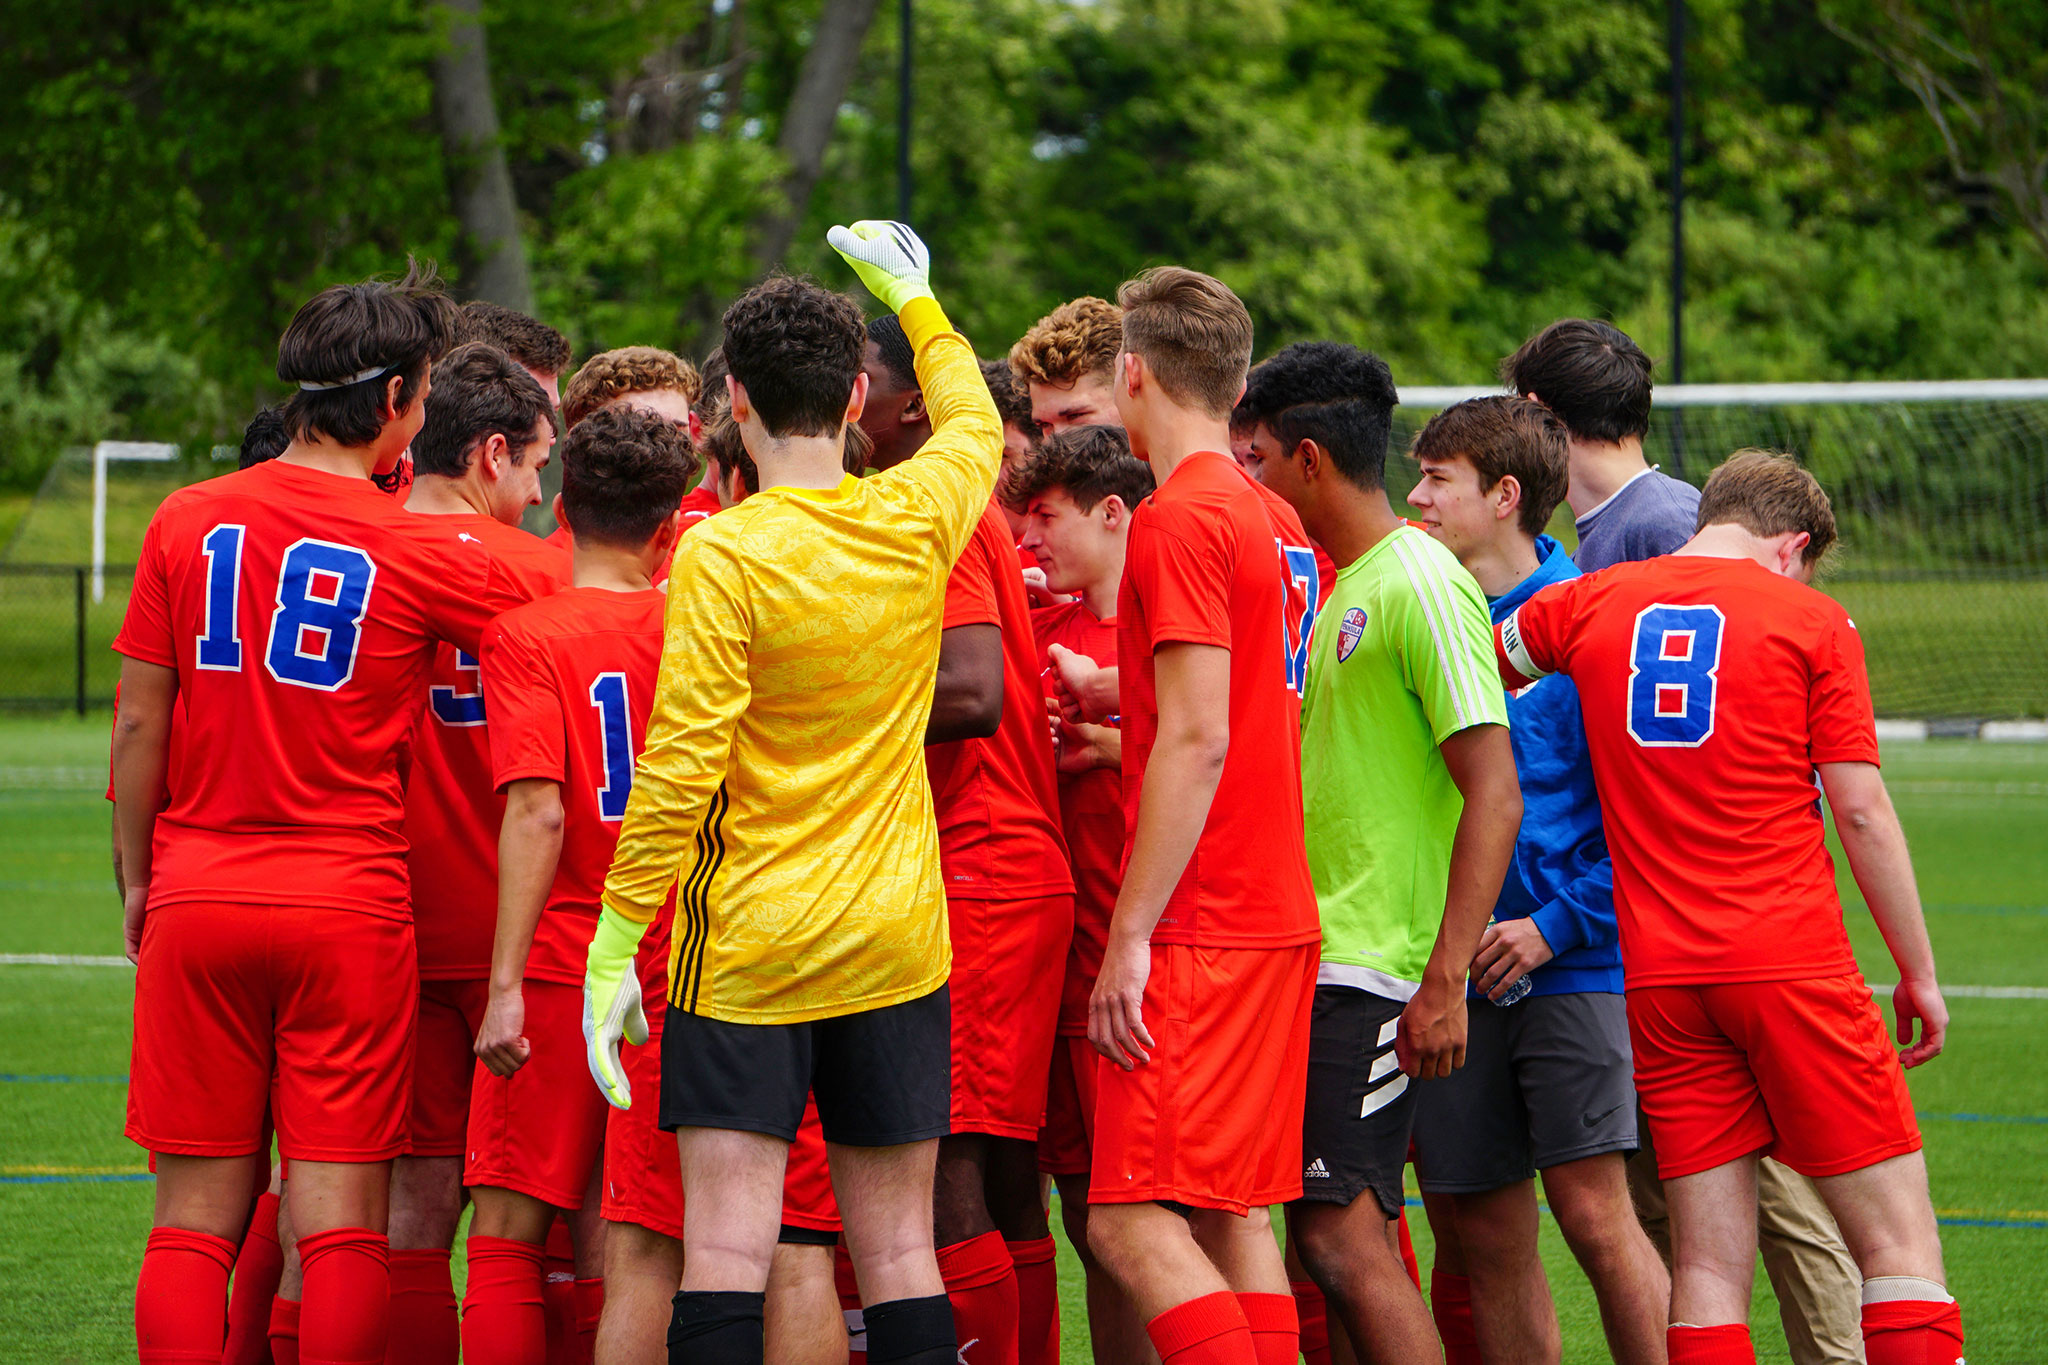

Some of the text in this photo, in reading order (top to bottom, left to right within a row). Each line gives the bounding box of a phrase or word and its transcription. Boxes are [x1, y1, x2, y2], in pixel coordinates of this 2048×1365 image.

[196, 523, 377, 692] 18
[1503, 614, 1519, 653] TAIN
[1627, 603, 1726, 748] 8
[589, 672, 635, 821] 1
[1304, 1170, 1330, 1178] adidas
